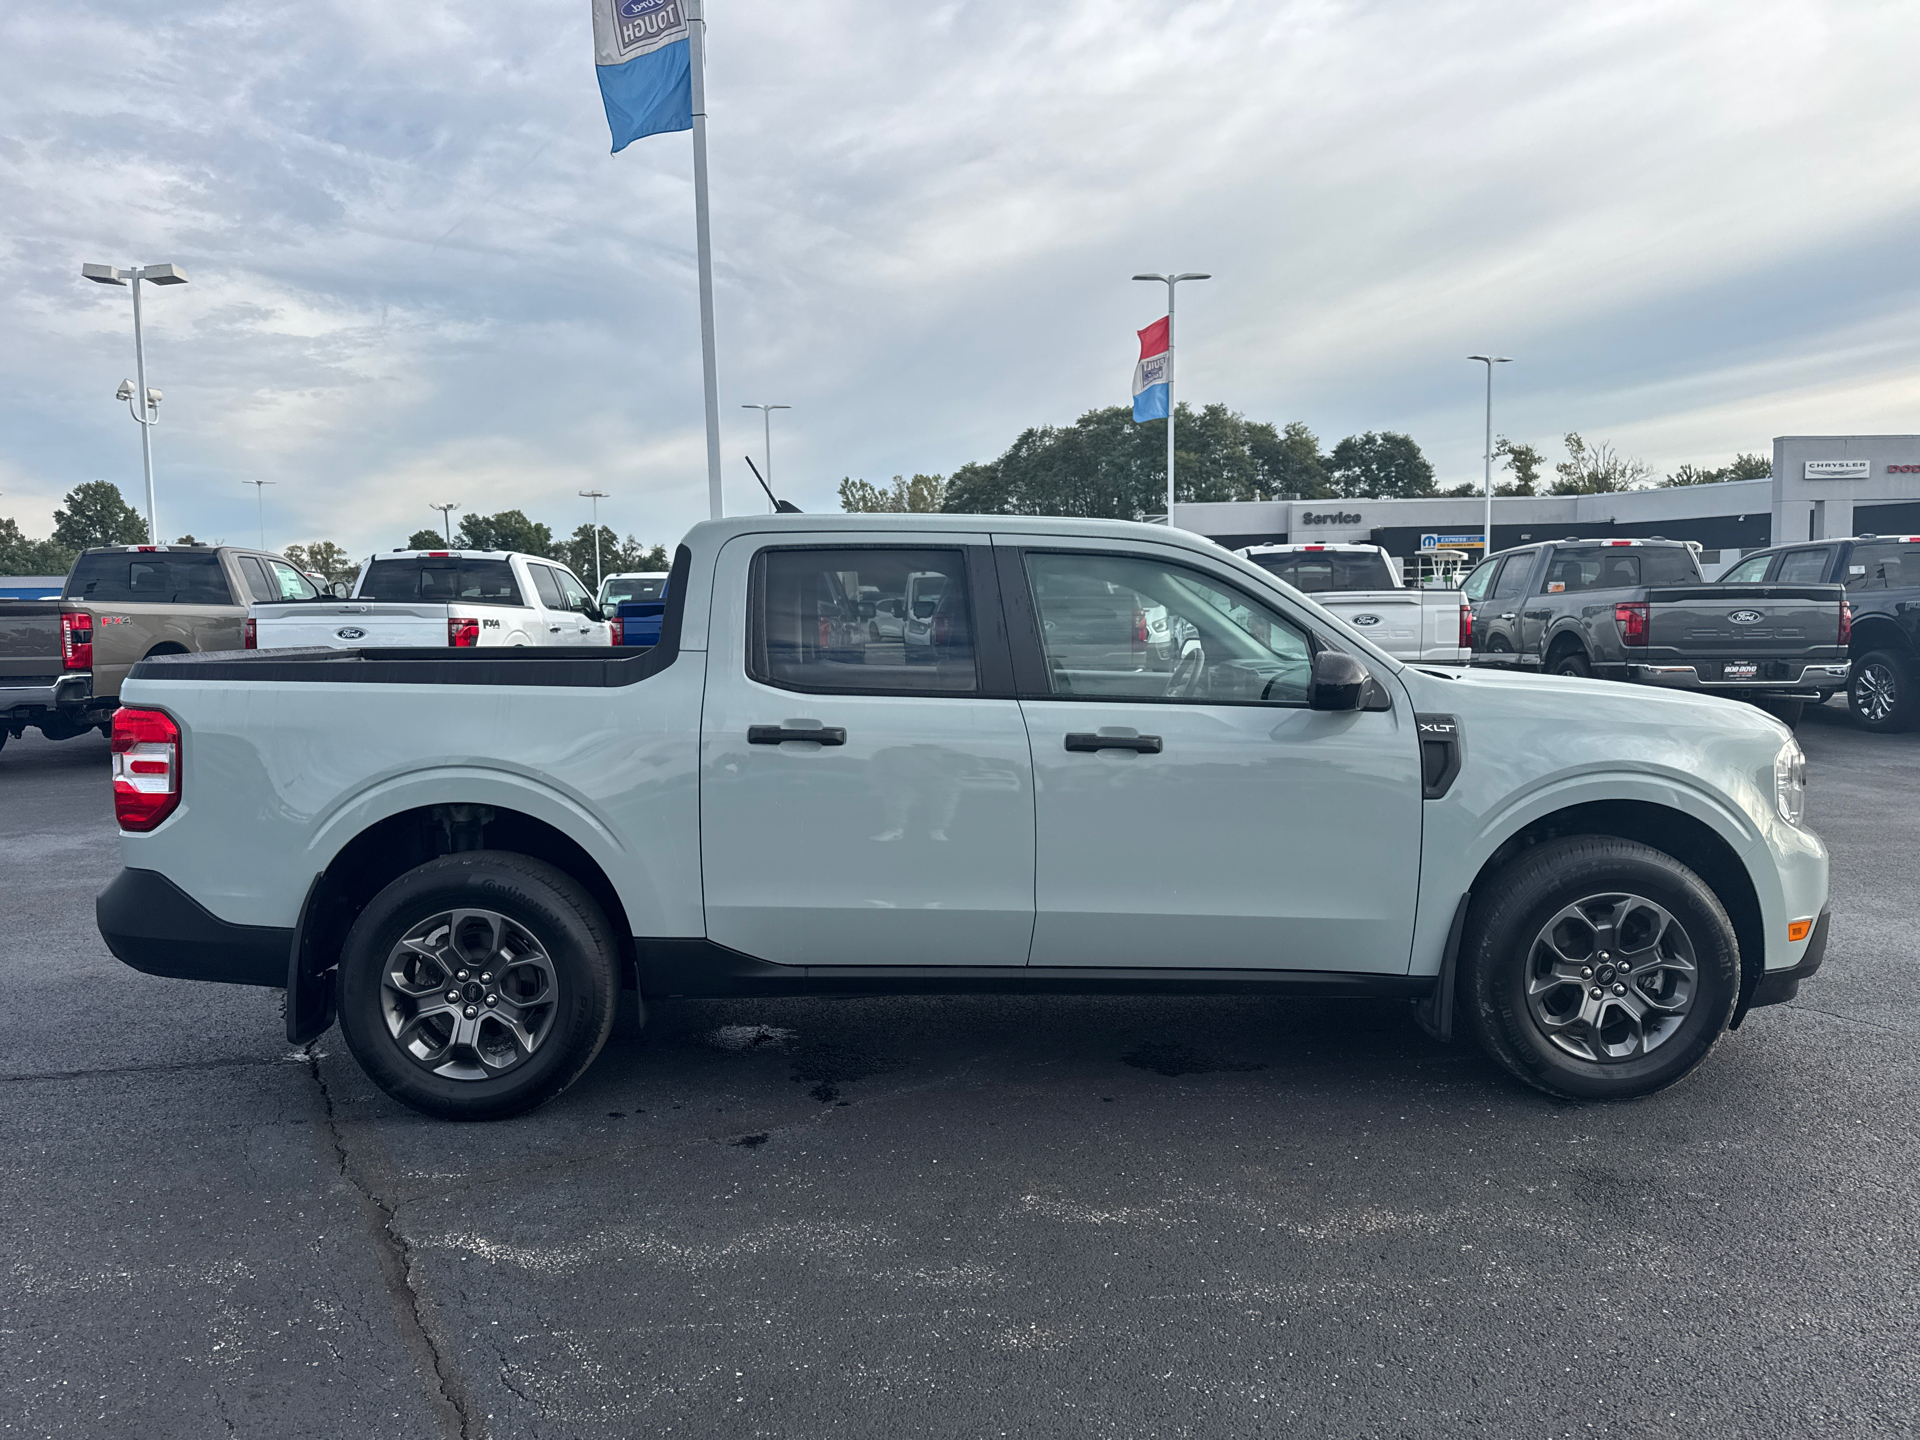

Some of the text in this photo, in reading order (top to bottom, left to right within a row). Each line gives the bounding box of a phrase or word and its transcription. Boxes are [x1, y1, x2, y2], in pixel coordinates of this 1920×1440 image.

[1303, 511, 1362, 525] Service
[101, 616, 132, 627] FX4
[1357, 616, 1376, 625] Ford
[1736, 612, 1755, 621] Ford
[483, 618, 500, 629] FX4
[342, 628, 360, 638] Ford
[1419, 723, 1455, 732] XLT
[481, 878, 561, 929] Continental
[1687, 894, 1732, 968] Continental
[1494, 991, 1541, 1064] Continental
